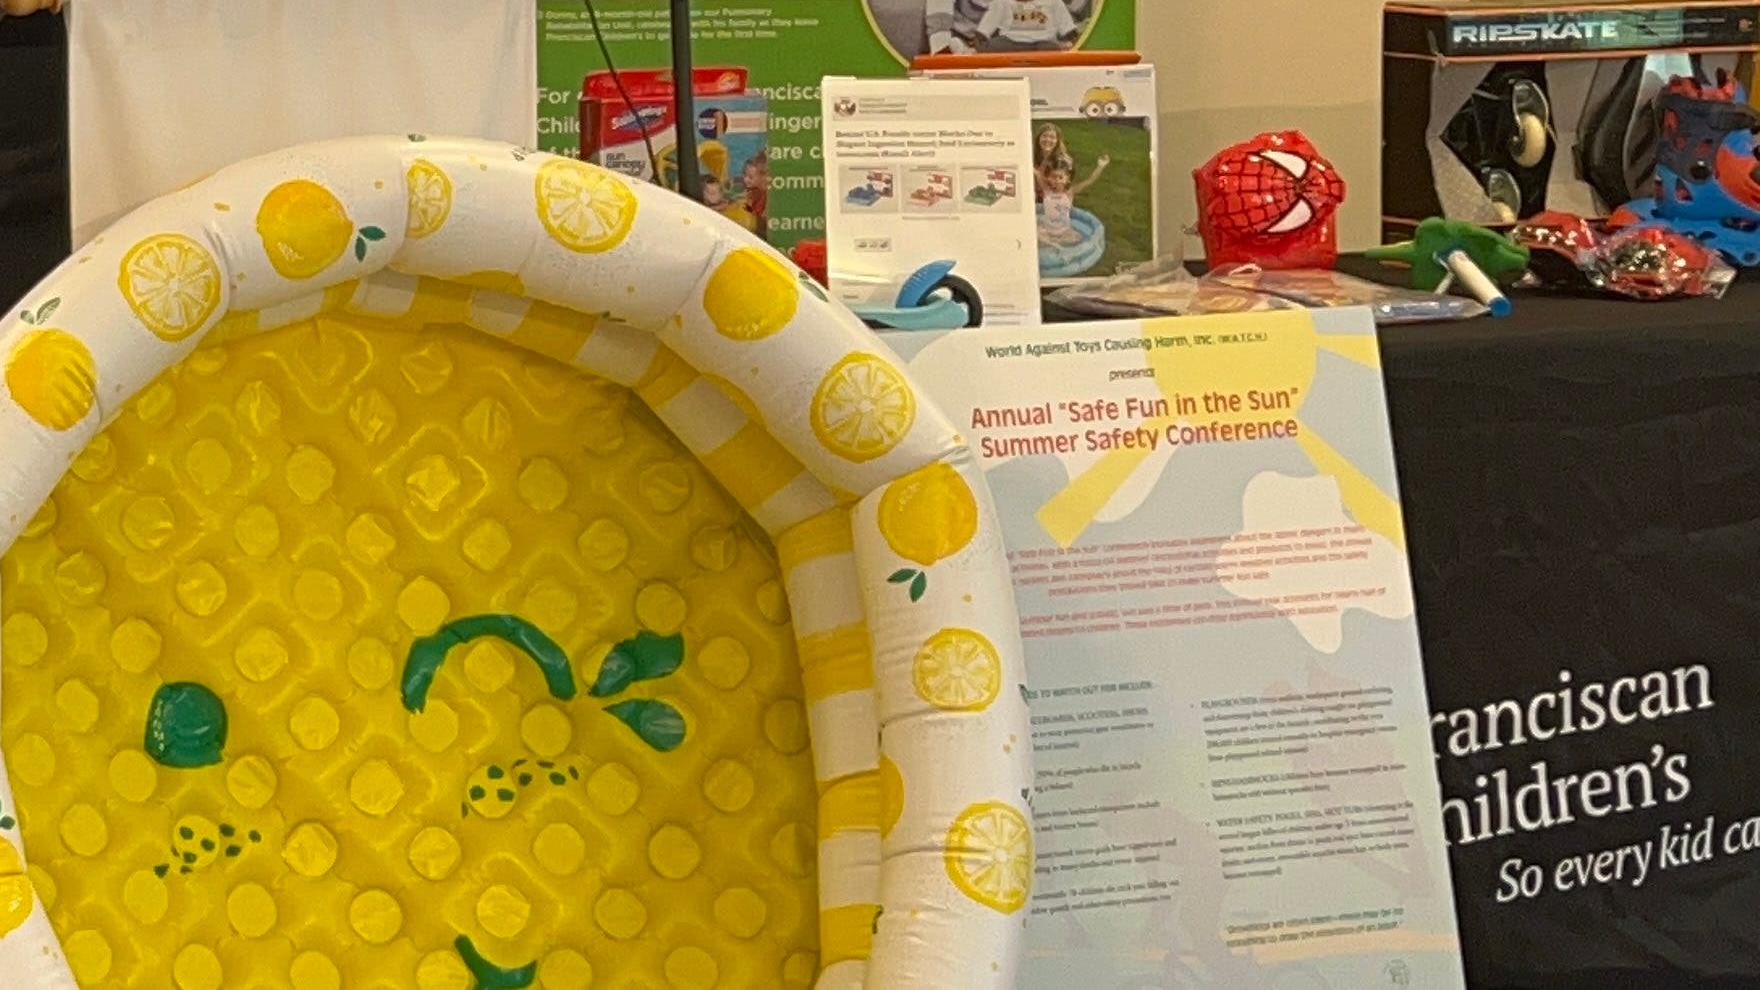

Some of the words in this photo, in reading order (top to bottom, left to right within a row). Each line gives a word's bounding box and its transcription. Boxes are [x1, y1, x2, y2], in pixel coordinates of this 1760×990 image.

[1453, 20, 1618, 43] RIPSKATE
[985, 345, 1022, 358] World
[1025, 341, 1071, 357] Against
[1075, 339, 1102, 354] Toys
[1104, 336, 1152, 352] Causing
[972, 403, 1052, 429] Annual
[1059, 399, 1120, 423] "Safe
[1126, 397, 1169, 419] Fun
[1176, 393, 1197, 415] in
[1203, 391, 1242, 414] the
[1247, 386, 1299, 411] Sun"
[981, 435, 1079, 459] Summer
[1086, 428, 1159, 452] Safety
[1166, 418, 1299, 446] Conference
[1496, 857, 1544, 904] So
[1553, 840, 1654, 888] every
[1659, 816, 1716, 870] kid
